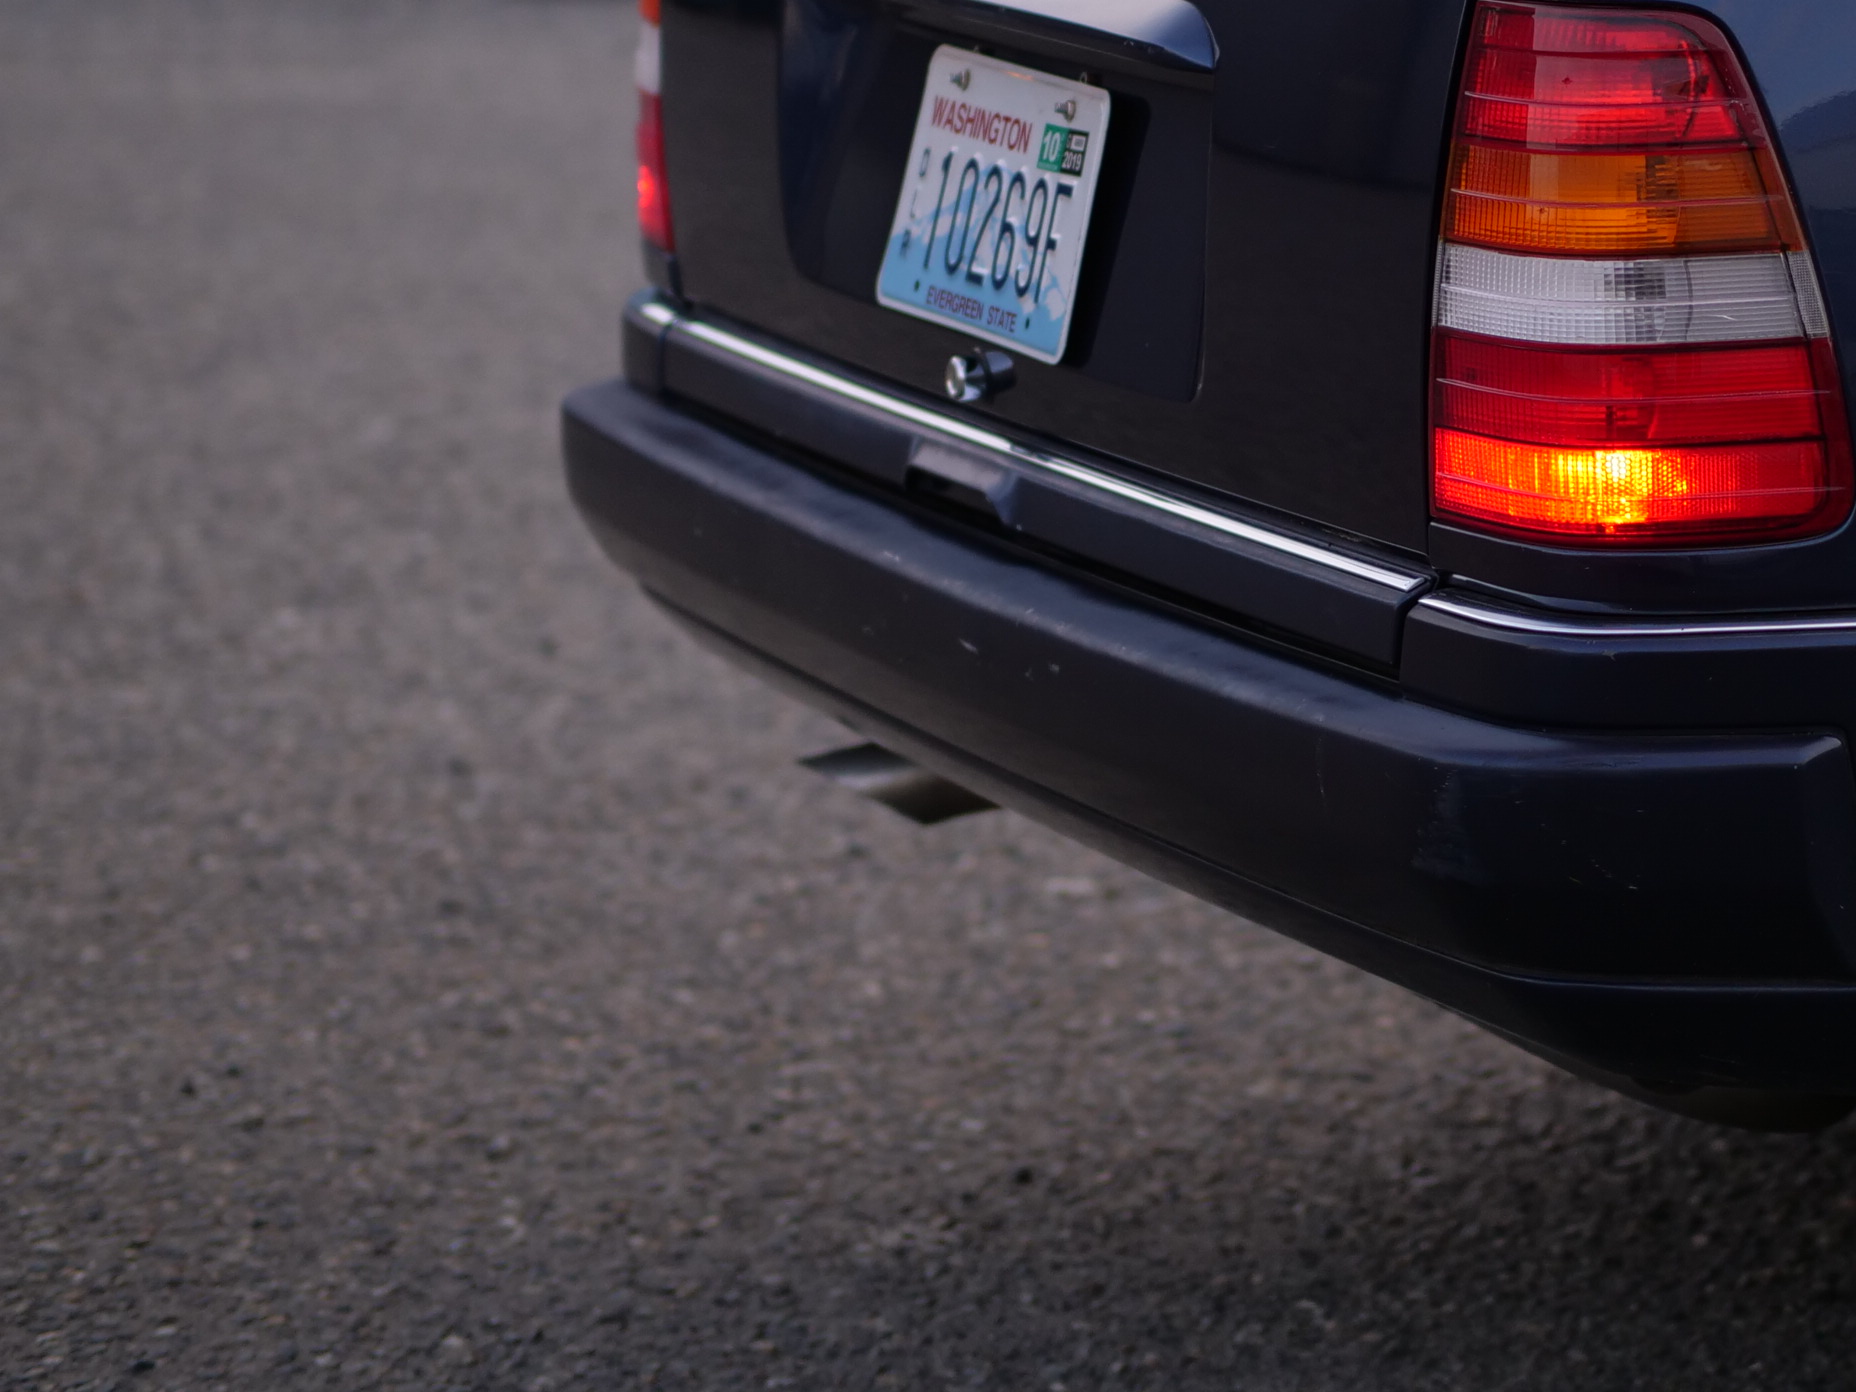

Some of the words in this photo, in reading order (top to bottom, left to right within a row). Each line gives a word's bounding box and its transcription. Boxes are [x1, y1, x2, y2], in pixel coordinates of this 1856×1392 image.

[932, 95, 1033, 154] WASHINGTON
[1042, 129, 1061, 162] 10
[1061, 151, 1083, 172] 2019
[923, 151, 1074, 303] 10269F
[926, 285, 984, 320] EVERGREEN
[986, 305, 1017, 333] STATE
